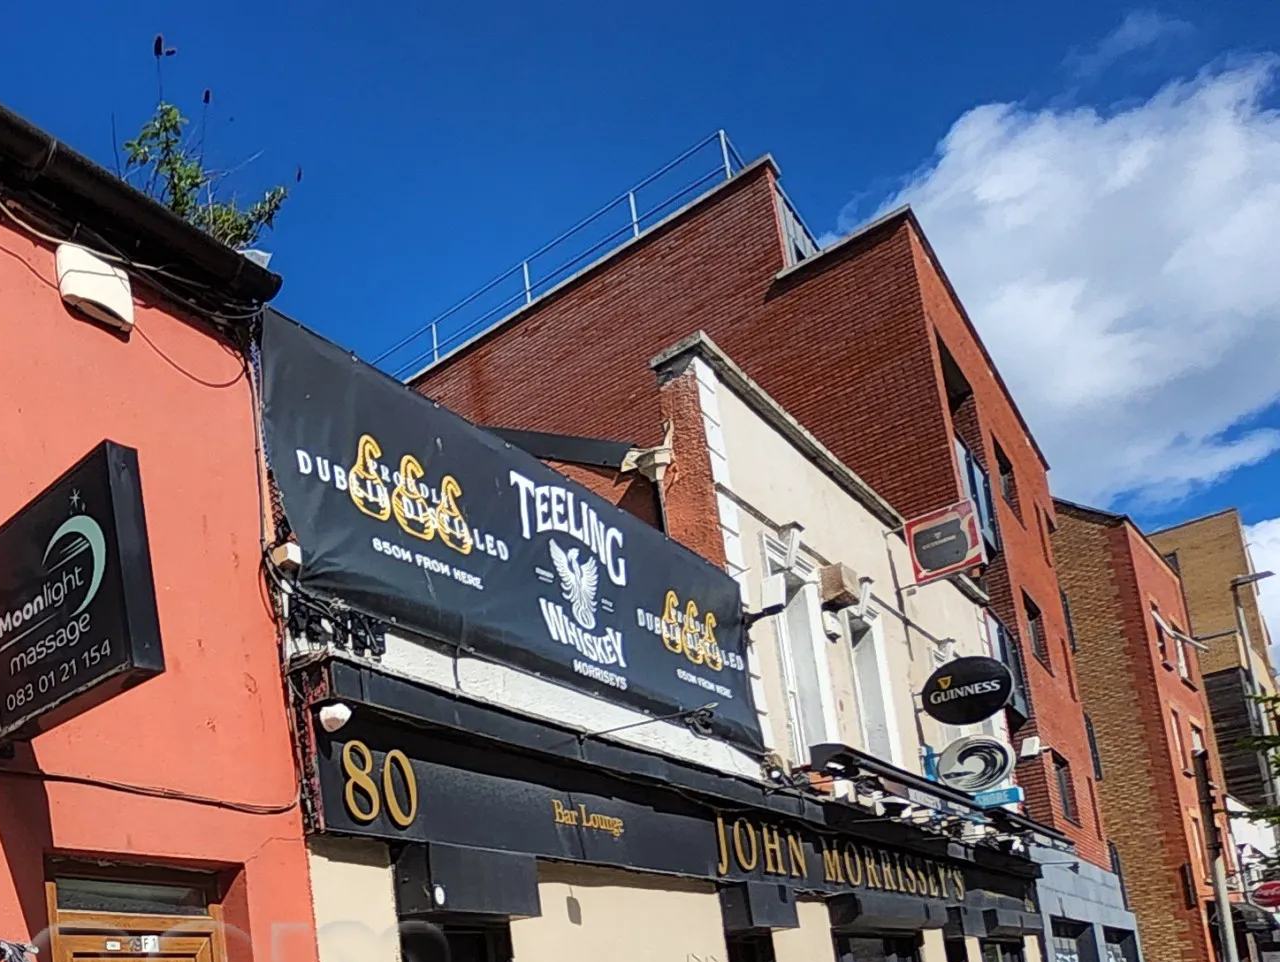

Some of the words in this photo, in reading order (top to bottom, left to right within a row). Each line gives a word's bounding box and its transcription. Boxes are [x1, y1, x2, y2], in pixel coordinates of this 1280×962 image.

[296, 449, 389, 508] DUBLIN
[510, 470, 627, 587] TEELING
[415, 554, 451, 578] FROM
[453, 567, 485, 591] HERE
[10, 612, 91, 676] massage
[539, 597, 627, 668] WHISKEY
[6, 684, 35, 712] 083
[38, 671, 55, 694] 01
[60, 659, 77, 683] 21
[83, 639, 111, 669] 154
[573, 659, 628, 691] MORRISEYS
[930, 679, 1001, 705] GUINNESS
[342, 740, 418, 827] 80
[552, 799, 578, 826] Bar
[581, 804, 624, 837] Lounge
[716, 812, 808, 878] JOHN
[822, 837, 966, 900] MORRISSEY'S
